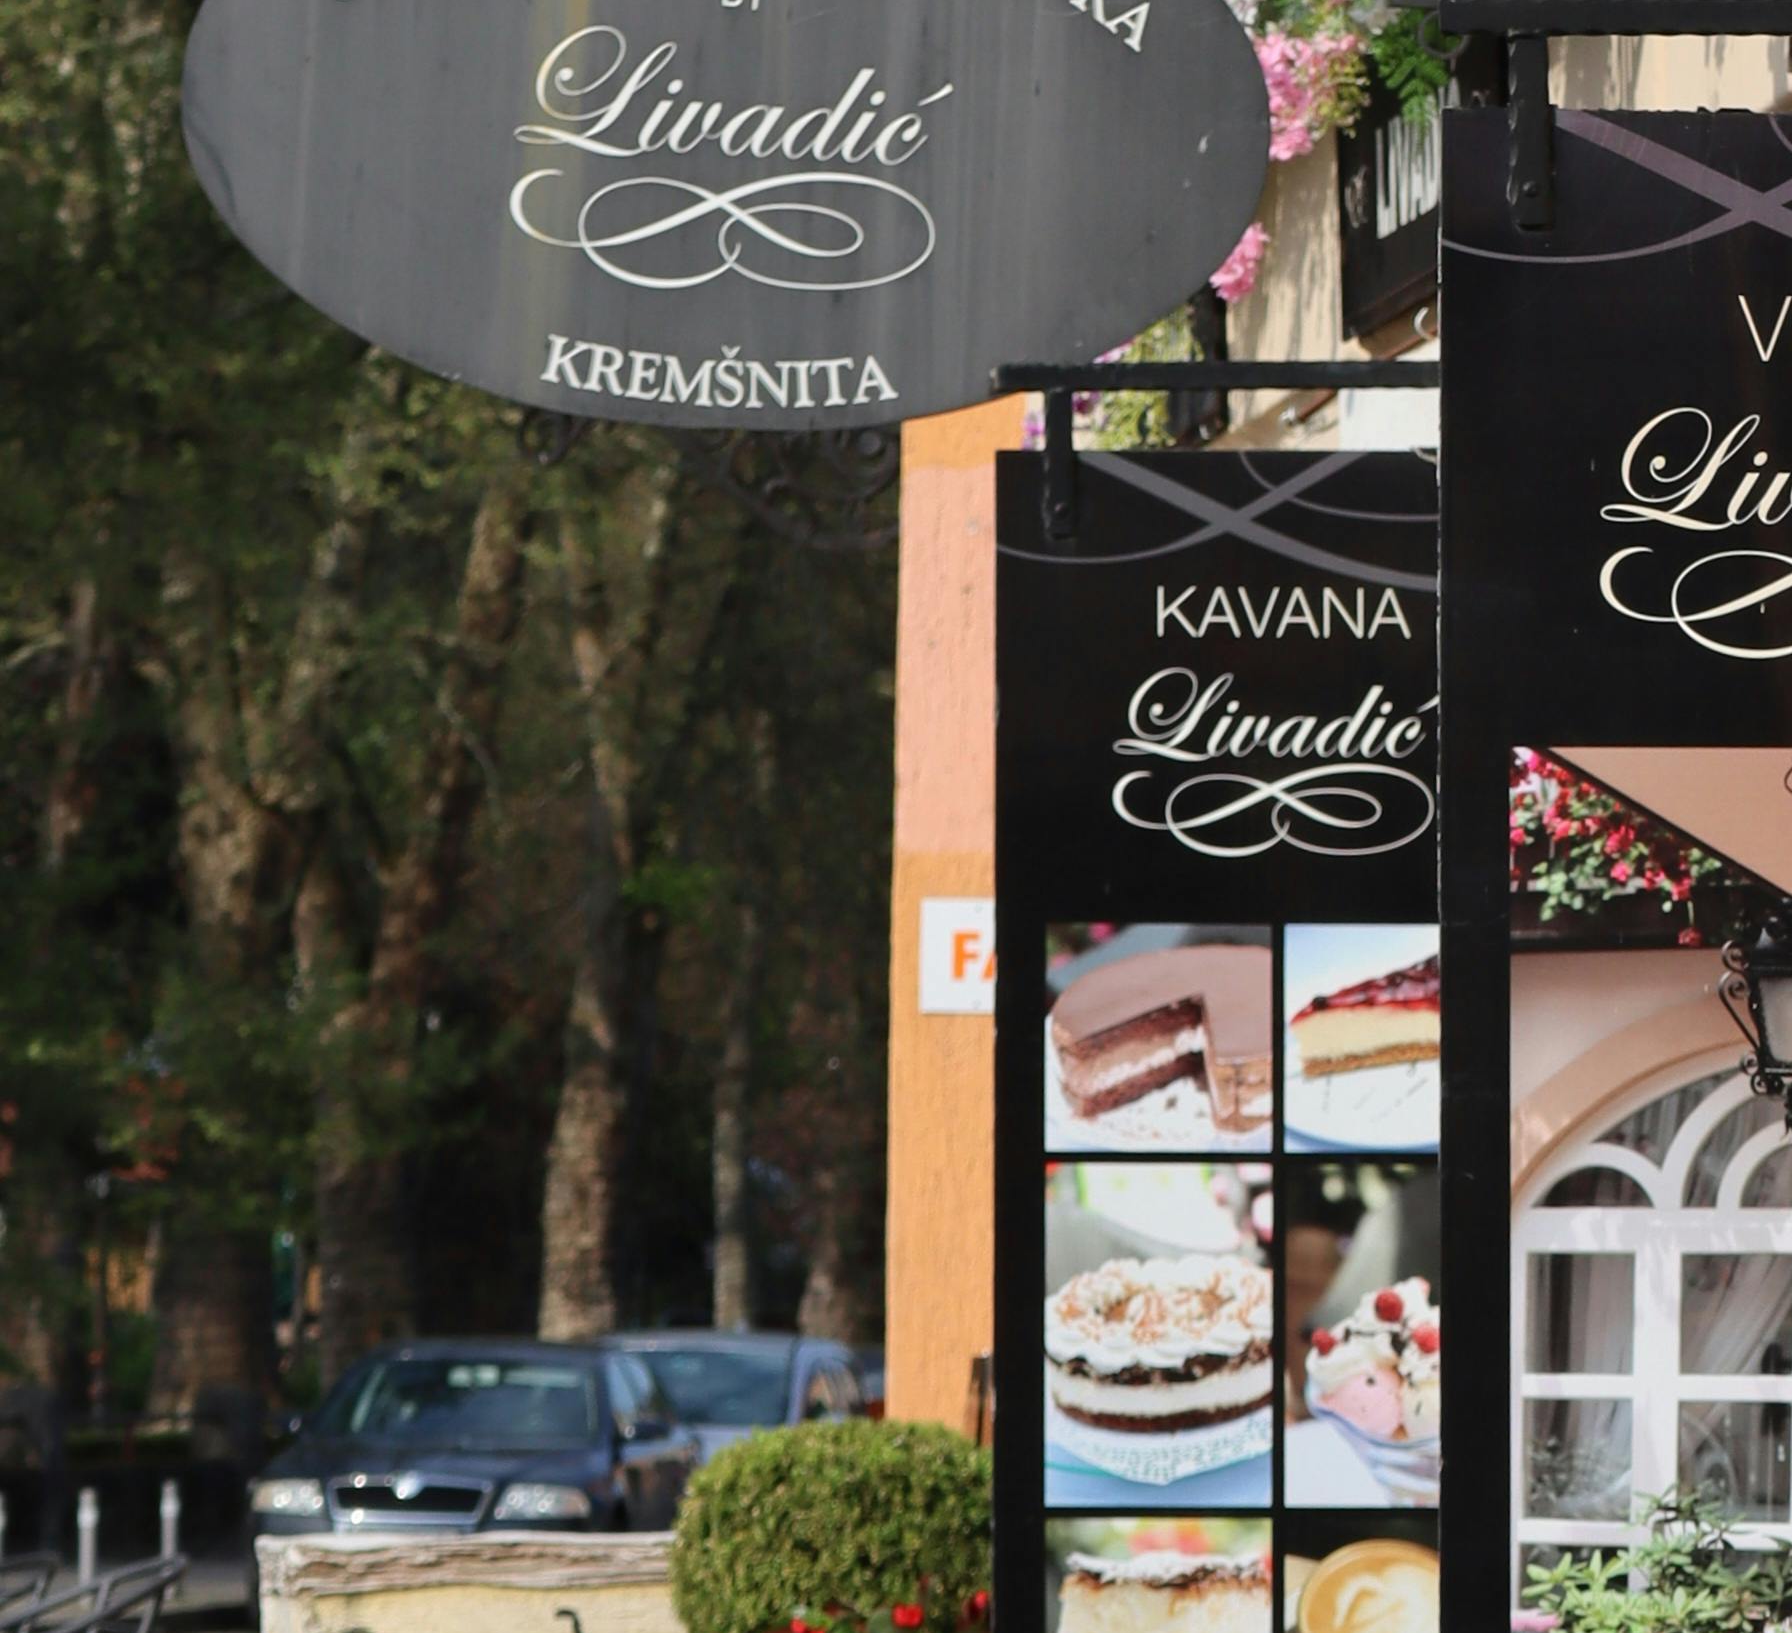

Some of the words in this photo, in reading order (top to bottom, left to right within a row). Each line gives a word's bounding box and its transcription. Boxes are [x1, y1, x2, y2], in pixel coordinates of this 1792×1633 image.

[512, 24, 954, 166] Livadić
[540, 334, 900, 409] KREMŠNITA
[1155, 585, 1413, 641] KAVANA
[1112, 666, 1439, 763] Livadić
